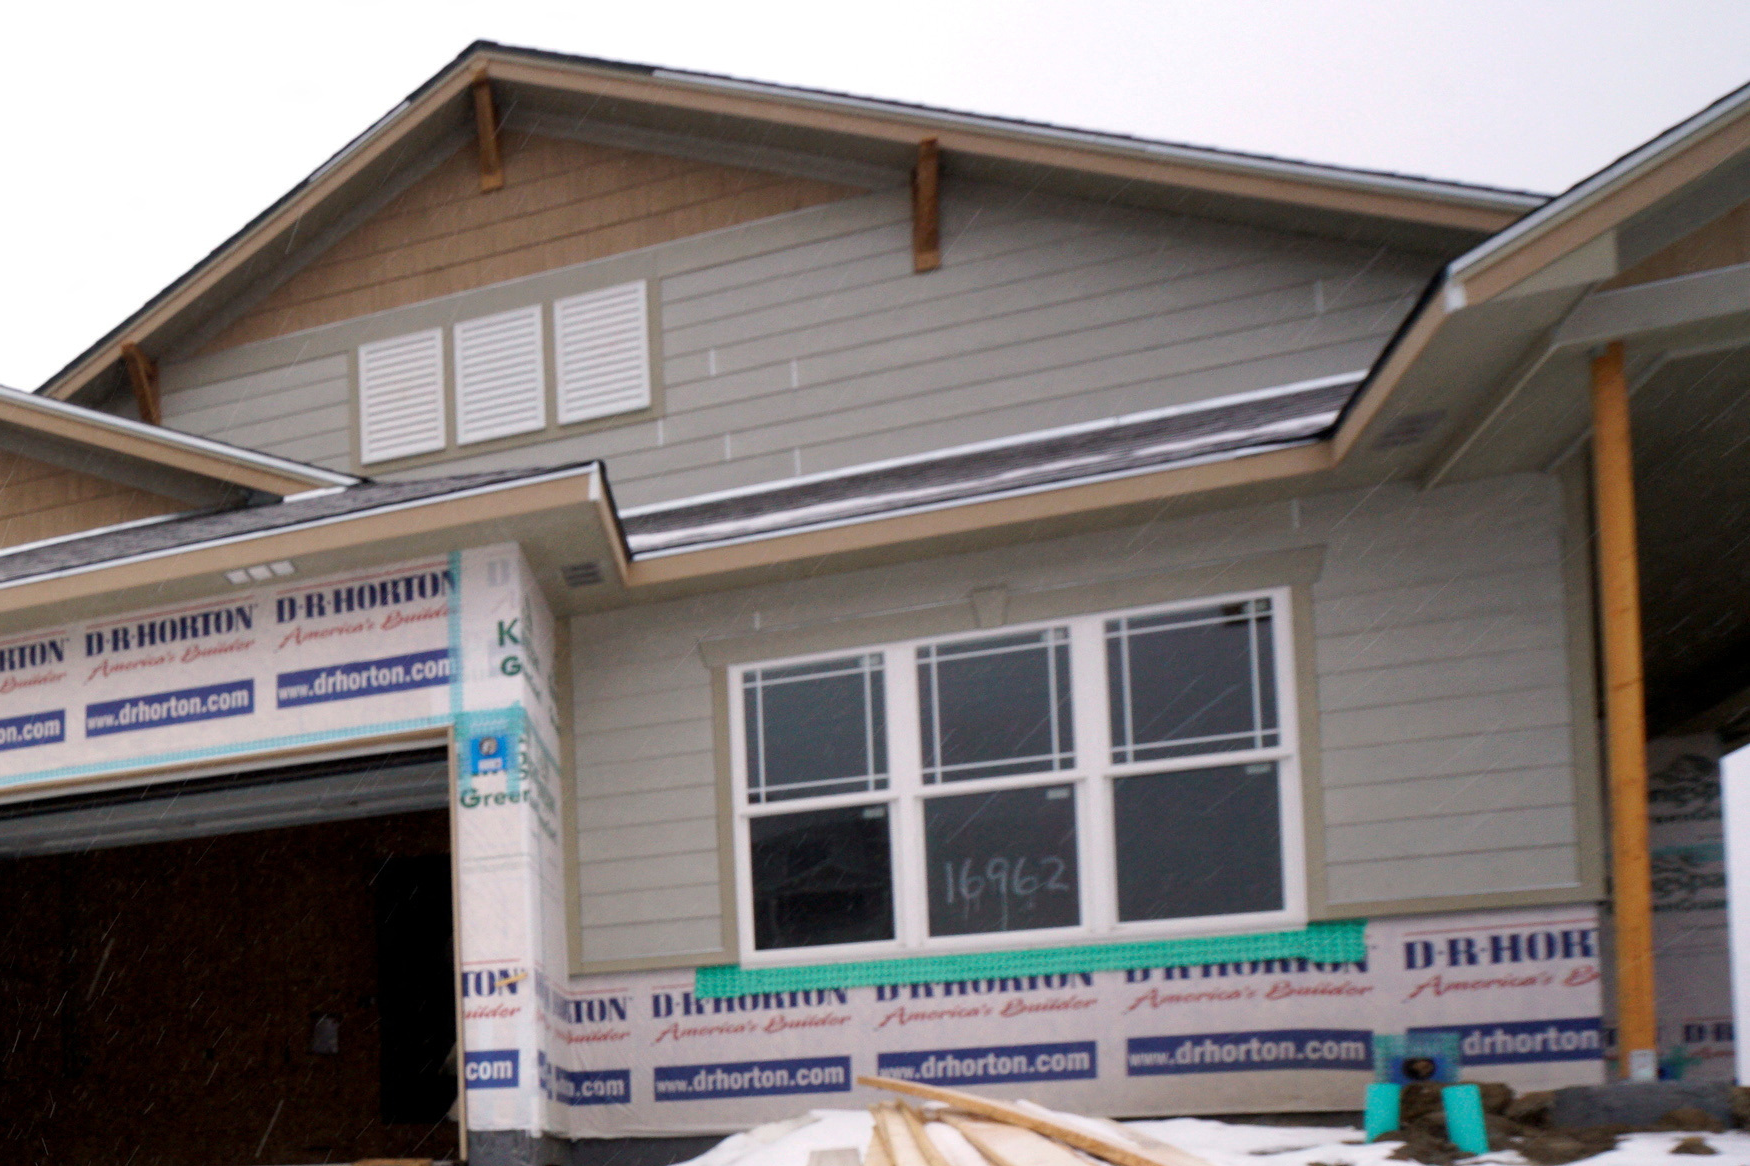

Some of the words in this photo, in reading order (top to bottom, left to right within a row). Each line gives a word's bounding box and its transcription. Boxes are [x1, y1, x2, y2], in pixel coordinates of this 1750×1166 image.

[180, 638, 256, 664] Builder
[0, 670, 67, 695] Builder
[86, 688, 250, 731] www.drhorton.com
[943, 856, 1072, 905] 16962
[1263, 979, 1374, 1002] Builder
[1000, 994, 1099, 1019] Builder
[763, 1010, 852, 1034] Builder
[1129, 1037, 1367, 1068] www.drhorton.com
[656, 1064, 846, 1093] www.drhorton.com
